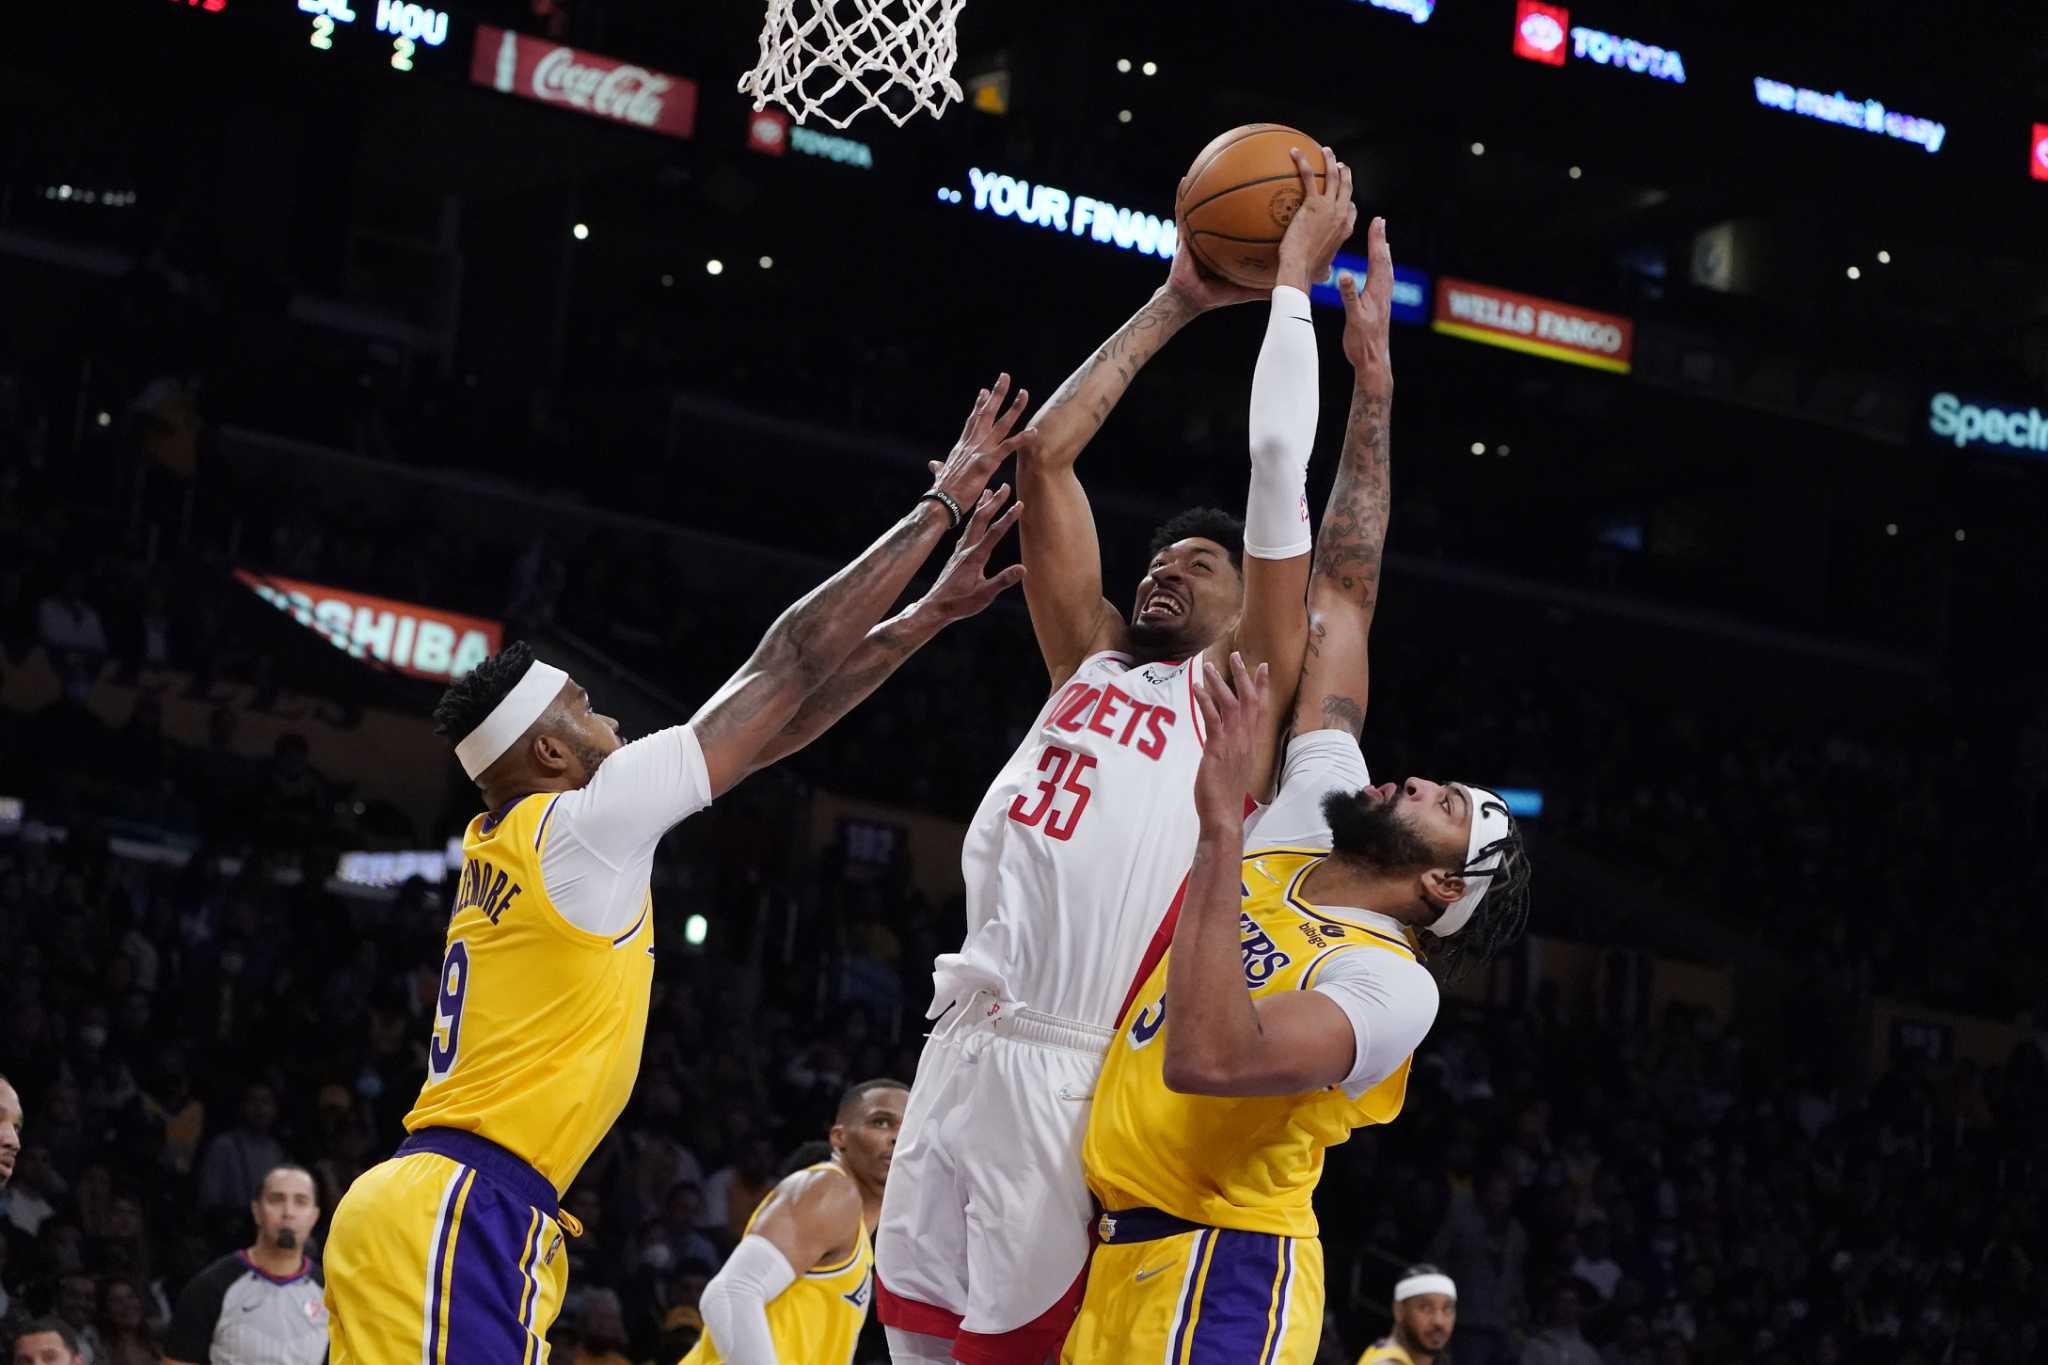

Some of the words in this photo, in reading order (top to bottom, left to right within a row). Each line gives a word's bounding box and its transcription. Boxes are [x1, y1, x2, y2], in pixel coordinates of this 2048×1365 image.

[310, 14, 335, 50] 2
[391, 35, 415, 72] 2
[375, 0, 448, 46] HOU
[1570, 26, 1686, 84] TOYOTA
[969, 167, 1070, 231] YOUR
[1448, 290, 1536, 335] WELLS
[1536, 310, 1622, 353] FARGO
[1007, 745, 1098, 841] 35
[1298, 921, 1327, 949] bibigo
[429, 939, 471, 1080] 9
